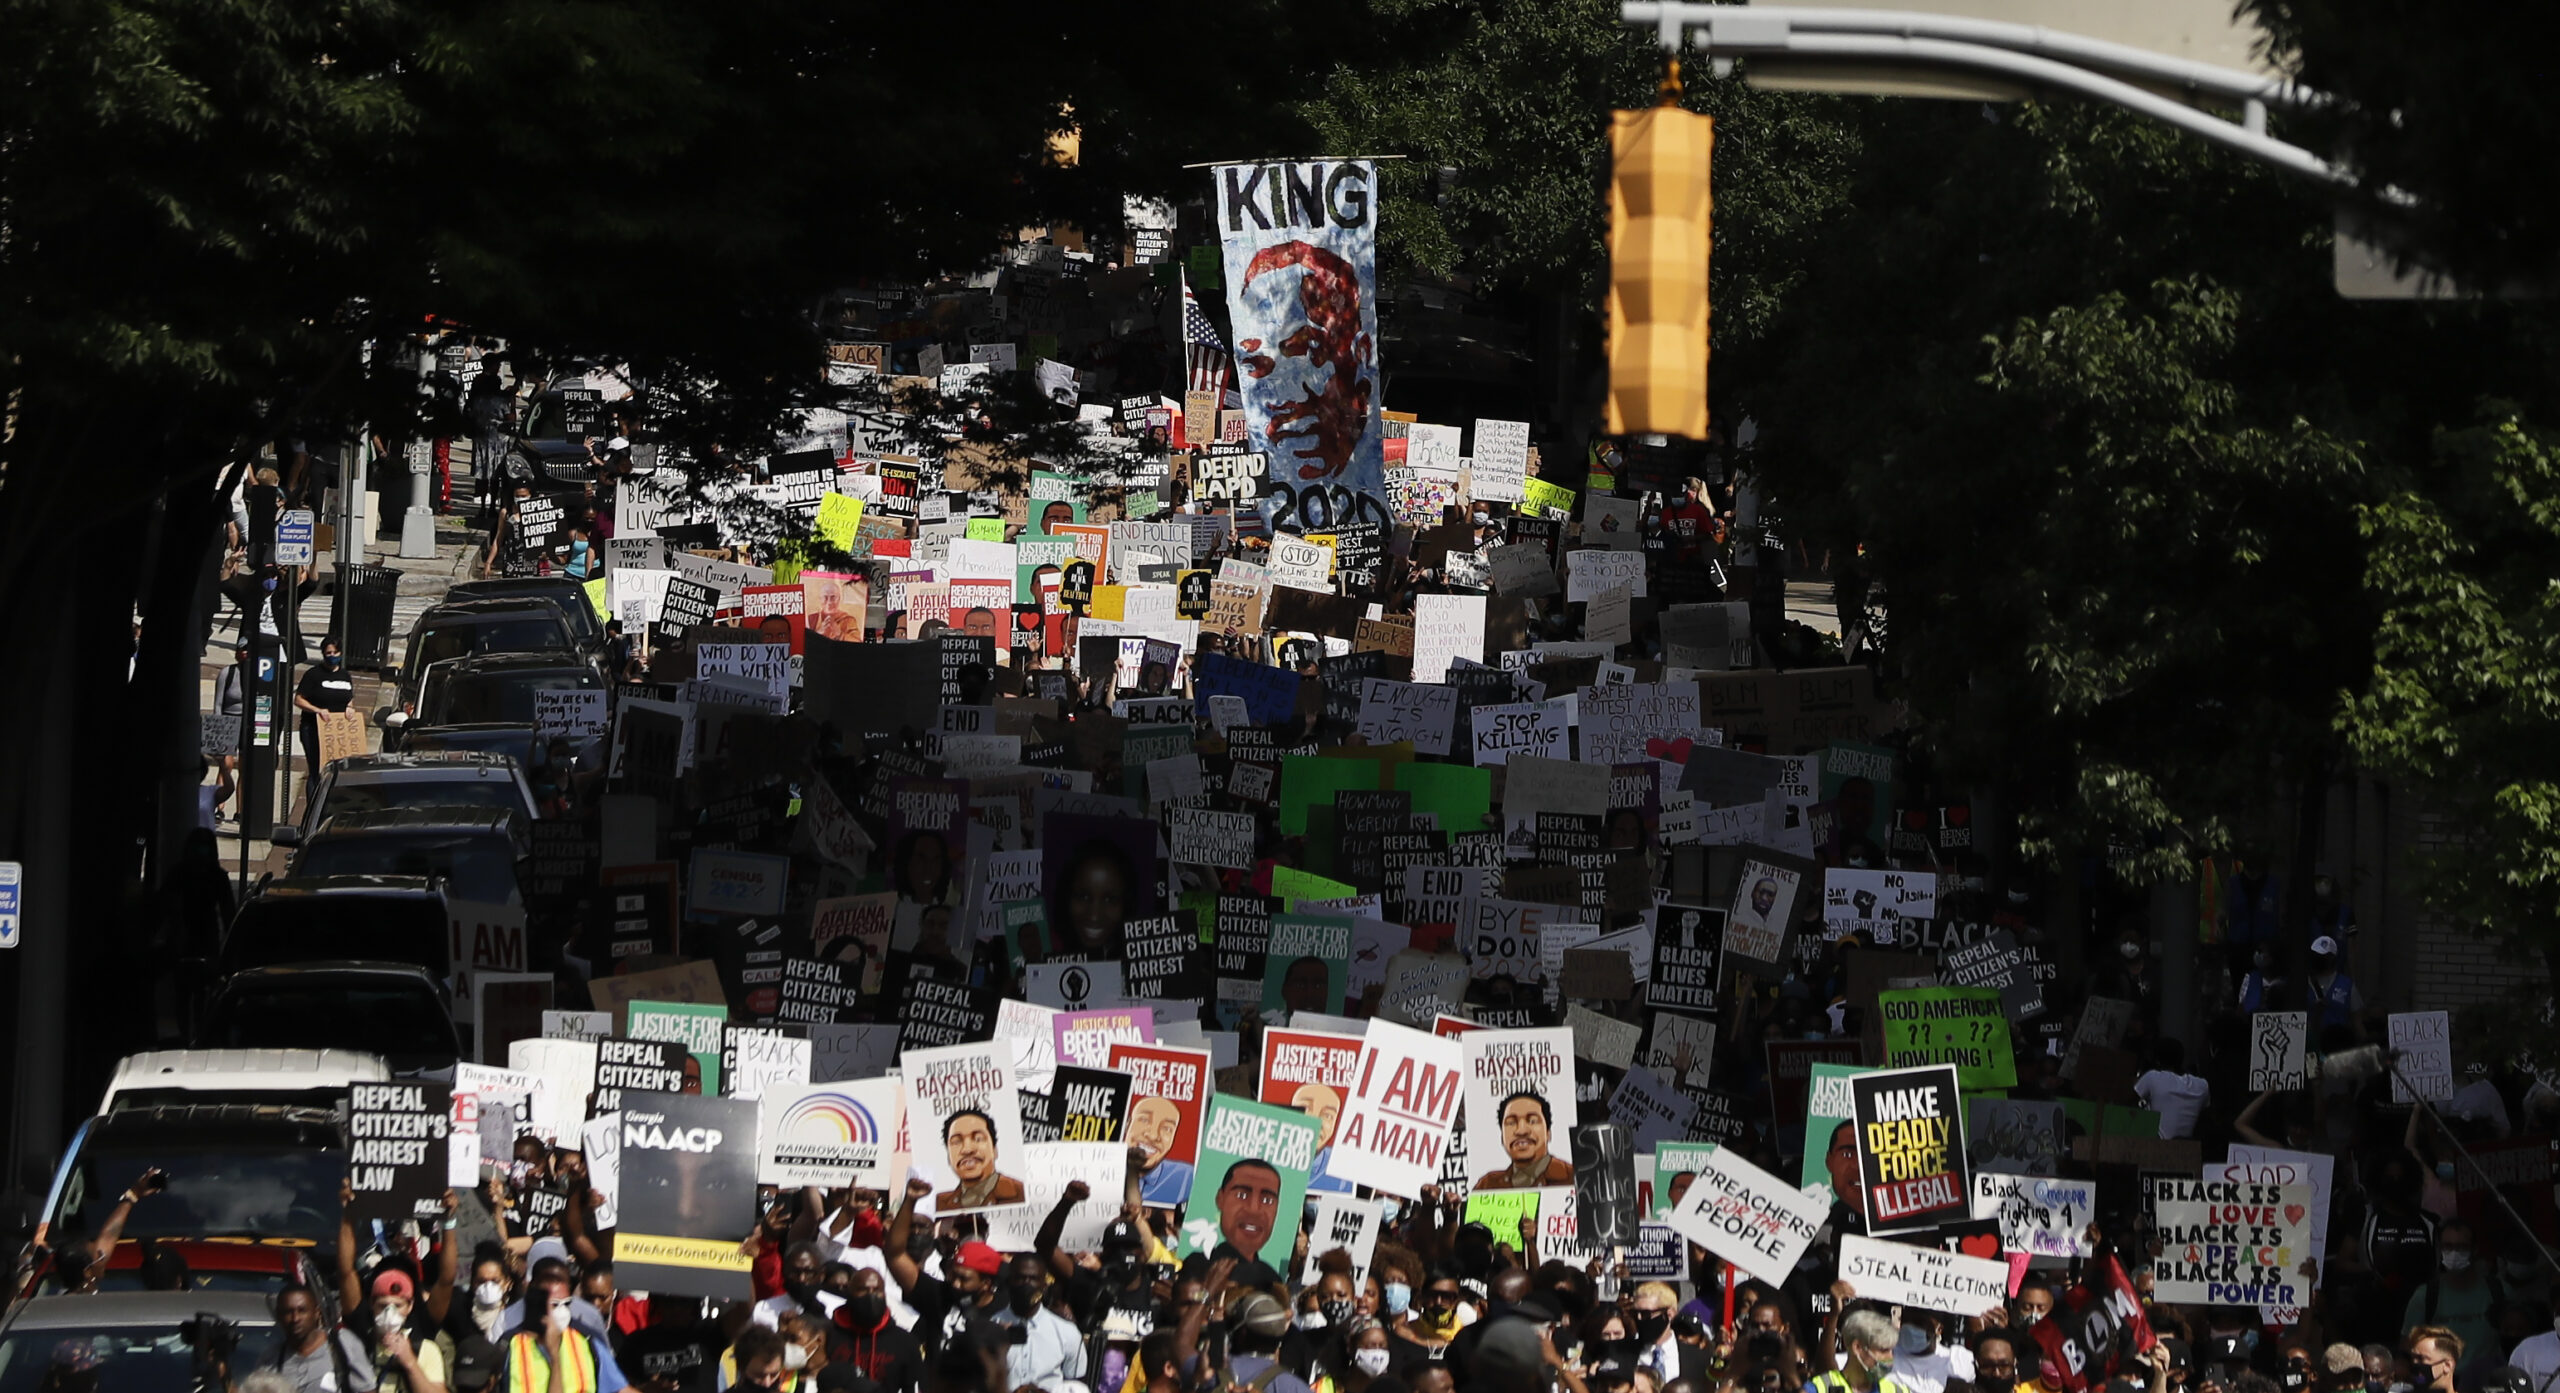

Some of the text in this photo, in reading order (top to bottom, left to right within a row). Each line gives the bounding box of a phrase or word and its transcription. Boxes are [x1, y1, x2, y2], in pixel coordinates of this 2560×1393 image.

[1225, 163, 1368, 231] KING
[1011, 246, 1062, 263] DEFUND
[1136, 240, 1168, 248] CITIZEN'S
[1136, 248, 1160, 256] ARREST
[1135, 256, 1150, 264] LAW
[1122, 396, 1152, 410] REPEAL
[1199, 455, 1266, 478] DEFUND
[773, 470, 820, 487] ENOUGH
[1207, 479, 1257, 499] APD
[1407, 486, 1430, 499] Black
[521, 499, 553, 513] REPEAL
[521, 508, 565, 524] CITIZEN'S
[831, 498, 848, 515] No
[1269, 481, 1393, 537] 2020
[522, 521, 557, 537] ARREST
[1112, 523, 1140, 539] END
[1143, 523, 1189, 544] POLICE
[1517, 521, 1549, 535] BLACK
[525, 535, 545, 548] LAW
[610, 540, 653, 549] BLACK
[1018, 543, 1074, 555] JUSTICE FOR
[620, 551, 648, 559] TRANS
[1285, 547, 1318, 562] STOP
[1575, 552, 1634, 563] THERE CAN
[1575, 565, 1640, 577] BE NO LOVE
[669, 580, 706, 600] REPEAL
[744, 591, 803, 605] REMEMBERING
[951, 585, 1010, 598] REMEMBERING
[666, 594, 715, 618] CITIZEN'S
[1209, 601, 1247, 615] BLACK
[659, 622, 683, 638] LAW
[663, 611, 703, 627] ARREST
[1357, 621, 1399, 645] Black
[701, 645, 790, 661] WHO DO YOU
[942, 639, 981, 650] REPEAL
[942, 653, 982, 665] REPEAL
[1503, 654, 1543, 670] BLACK
[1369, 682, 1450, 707] ENOUGH
[1711, 681, 1759, 706] BLM
[1799, 679, 1854, 701] BLM
[944, 710, 980, 732] END
[1128, 705, 1194, 724] BLACK
[1388, 707, 1423, 723] IS
[1495, 713, 1541, 731] STOP
[1229, 729, 1274, 745] REPEAL
[1362, 723, 1443, 746] ENOUGH
[1477, 728, 1560, 748] KILLING
[1229, 745, 1286, 760] CITIZEN'S
[896, 792, 960, 813] BREONNA
[904, 810, 950, 830] TAYLOR
[1174, 808, 1214, 827] BLACK
[1539, 816, 1586, 832] REPEAL
[1383, 834, 1431, 850] REPEAL
[1539, 832, 1600, 848] CITIZEN'S
[1384, 851, 1447, 867] CITIZEN'S
[1423, 869, 1463, 895] END
[1884, 875, 1904, 888] NO
[1219, 897, 1267, 916] REPEAL
[1125, 915, 1179, 940] REPEAL
[1479, 904, 1543, 934] BYE
[1218, 937, 1268, 953] ARREST
[1273, 923, 1350, 945] JUSTICE FOR
[473, 921, 523, 970] AM
[1126, 935, 1198, 961] CITIZEN'S
[1477, 934, 1539, 960] DON
[1658, 946, 1714, 966] BLACK
[1949, 939, 2001, 971] REPEAL
[785, 957, 842, 984] REPEAL
[1129, 956, 1185, 980] ARREST
[1218, 953, 1246, 970] LAW
[1955, 949, 2021, 987] CITIZEN'S
[1662, 965, 1708, 986] LIVES
[781, 979, 857, 1008] CITIZEN'S
[914, 980, 972, 1008] REPEAL
[1131, 981, 1162, 999] LAW
[1651, 984, 1715, 1007] MATTER
[779, 1001, 840, 1025] ARREST
[908, 1000, 985, 1032] CITIZEN'S
[1884, 1001, 1920, 1021] GOD
[562, 1016, 586, 1033] NO
[902, 1022, 965, 1045] ARREST
[2392, 1017, 2444, 1044] BLACK
[746, 1038, 801, 1064] BLACK
[1062, 1026, 1144, 1058] BREONNA
[1485, 1041, 1551, 1057] JUSTICE FOR
[601, 1040, 666, 1067] REPEAL
[1274, 1042, 1357, 1069] JUSTICE FOR
[1892, 1050, 1930, 1068] HOW
[923, 1056, 993, 1078] JUSTICE FOR
[1118, 1055, 1197, 1086] JUSTICE FOR
[1271, 1062, 1355, 1088] MANUEL ELLIS
[1475, 1055, 1562, 1079] RAYSHARD
[598, 1065, 684, 1094] CITIZEN'S
[916, 1068, 1004, 1100] RAYSHARD
[1357, 1048, 1461, 1123] I AM
[1491, 1076, 1548, 1097] BROOKS
[2252, 1069, 2304, 1091] BLM
[2395, 1074, 2450, 1098] MATTER
[351, 1085, 428, 1112] REPEAL
[933, 1094, 992, 1117] BROOKS
[1064, 1082, 1117, 1119] MAKE
[1624, 1081, 1678, 1124] LEGALIZE
[1873, 1086, 1941, 1124] MAKE
[351, 1113, 448, 1140] CITIZEN'S
[625, 1109, 665, 1125] Georgia
[1213, 1106, 1315, 1147] JUSTICE FOR
[624, 1124, 723, 1153] NAACP
[1342, 1112, 1442, 1170] A MAN
[1866, 1116, 1952, 1156] DEADLY
[351, 1139, 430, 1165] ARREST
[776, 1144, 879, 1158] RAINBOW PUSH
[1206, 1127, 1311, 1172] GEORGE FLOYD
[1576, 1123, 1634, 1172] STOP
[1879, 1147, 1948, 1184] FORCE
[351, 1167, 396, 1192] LAW
[1574, 1170, 1635, 1206] KILLING
[1981, 1177, 2029, 1202] Black
[1699, 1165, 1817, 1241] PREACHERS
[1876, 1175, 1960, 1220] ILLEGAL
[2158, 1182, 2282, 1203] BLACK IS
[1713, 1196, 1748, 1223] FOR
[2000, 1201, 2051, 1229] fighting
[2209, 1206, 2276, 1226] LOVE
[1331, 1226, 1359, 1245] NOT
[1695, 1200, 1786, 1261] PEOPLE
[2158, 1225, 2282, 1246] BLACK IS
[622, 1240, 746, 1267] #WeAreDoneDying
[1911, 1251, 1952, 1268] THEY
[2207, 1245, 2291, 1267] PEACE
[1848, 1256, 2006, 1299] STEAL ELECTIONS
[2156, 1262, 2282, 1285] BLACK IS
[2208, 1284, 2295, 1304] POWER
[2063, 1284, 2139, 1377] BLM
